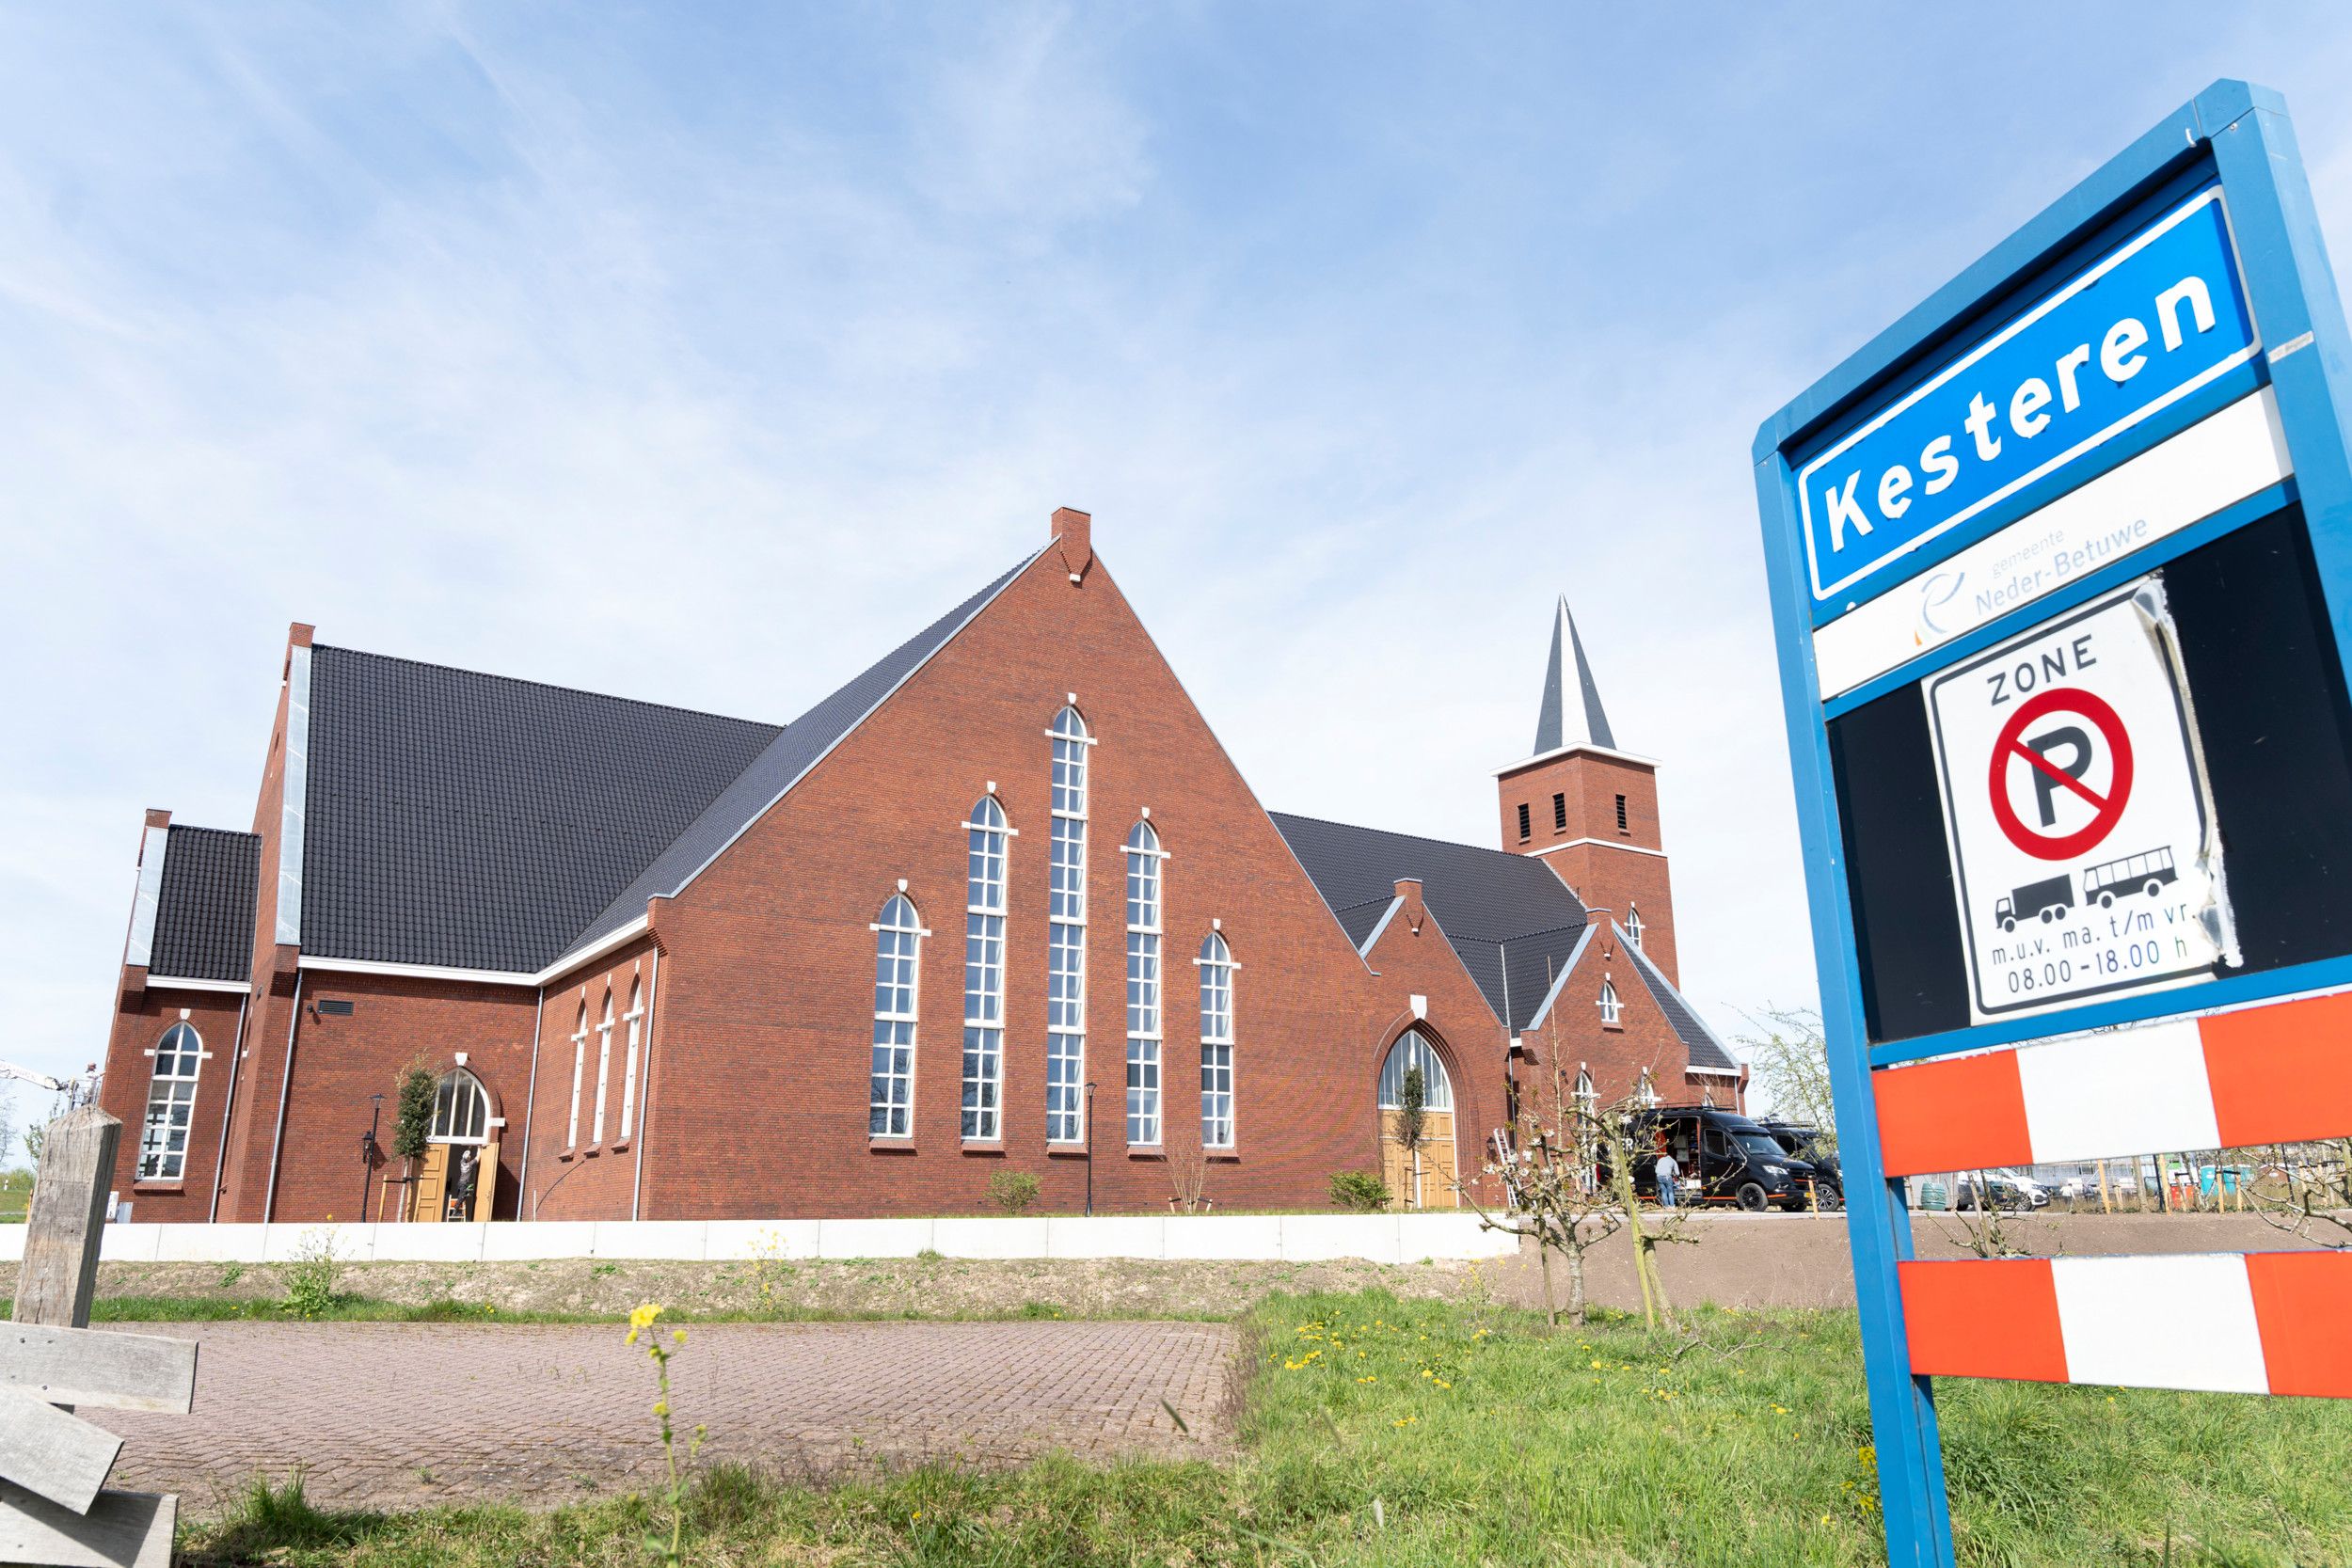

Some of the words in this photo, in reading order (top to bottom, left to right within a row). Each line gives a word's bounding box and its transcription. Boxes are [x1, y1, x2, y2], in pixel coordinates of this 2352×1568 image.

[1825, 277, 2216, 552] Kesteren
[1976, 518, 2149, 616] Neder-Betuwe
[1993, 529, 2065, 579] gemeente
[1987, 634, 2097, 705] ZONE
[1992, 938, 2051, 966] m.u.v.
[2062, 927, 2101, 949] ma.
[2108, 910, 2154, 939] t/m
[2164, 903, 2197, 925] vr.
[2175, 936, 2188, 958] h
